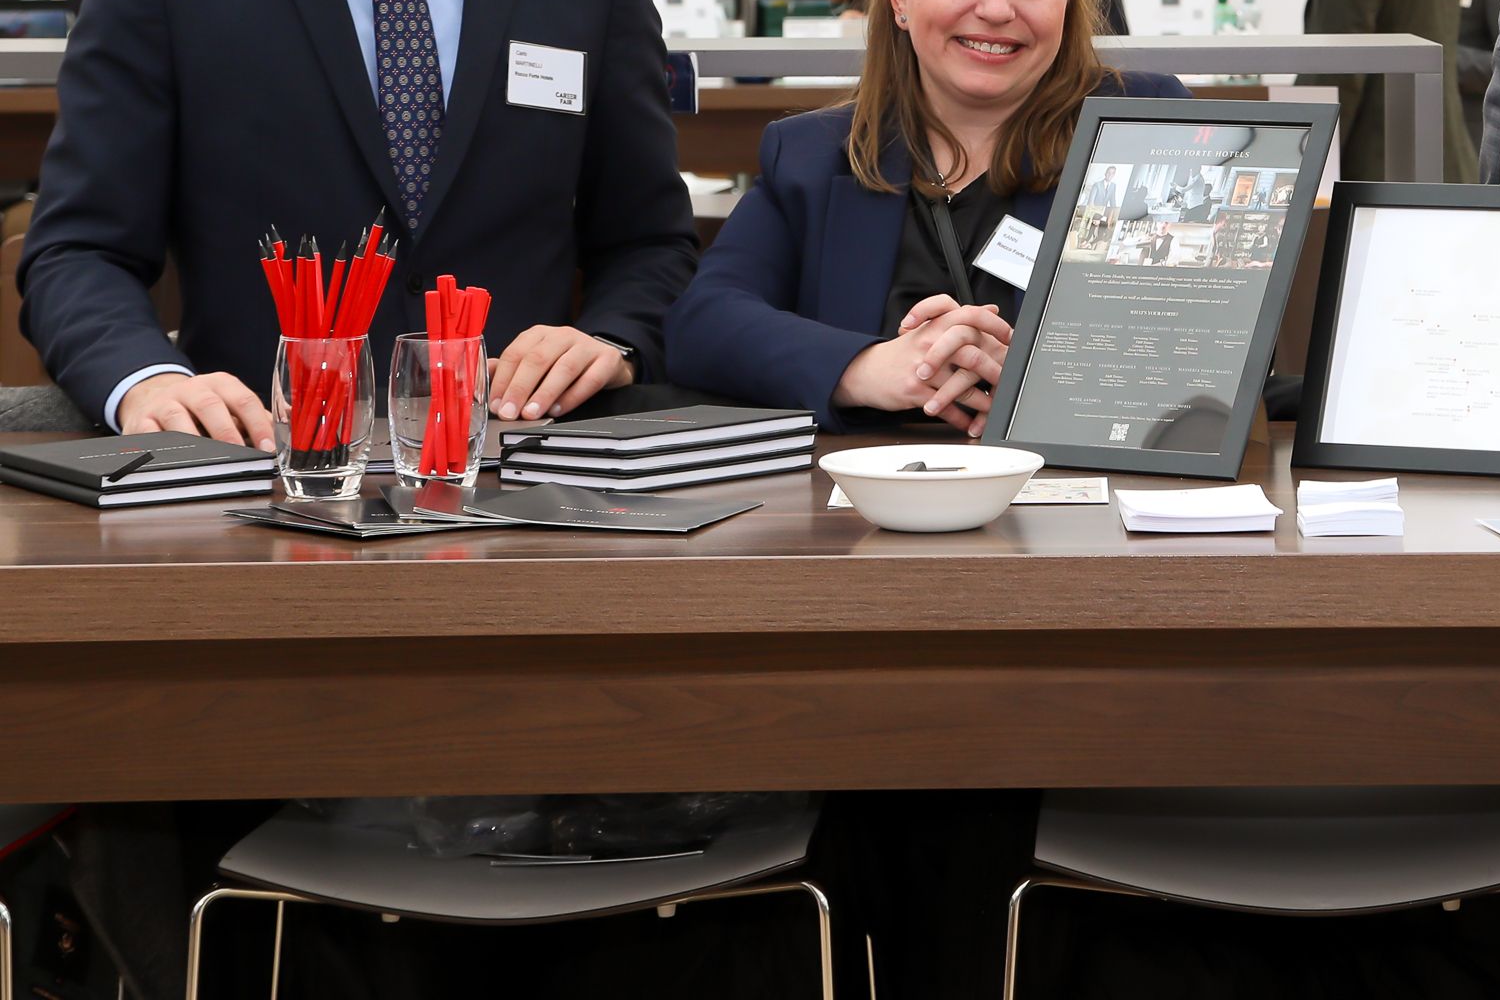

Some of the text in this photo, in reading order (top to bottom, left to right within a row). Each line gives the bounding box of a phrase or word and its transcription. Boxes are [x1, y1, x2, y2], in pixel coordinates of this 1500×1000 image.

[555, 92, 577, 101] CAREER
[1150, 148, 1251, 159] ROCCO FORTE HOTELS
